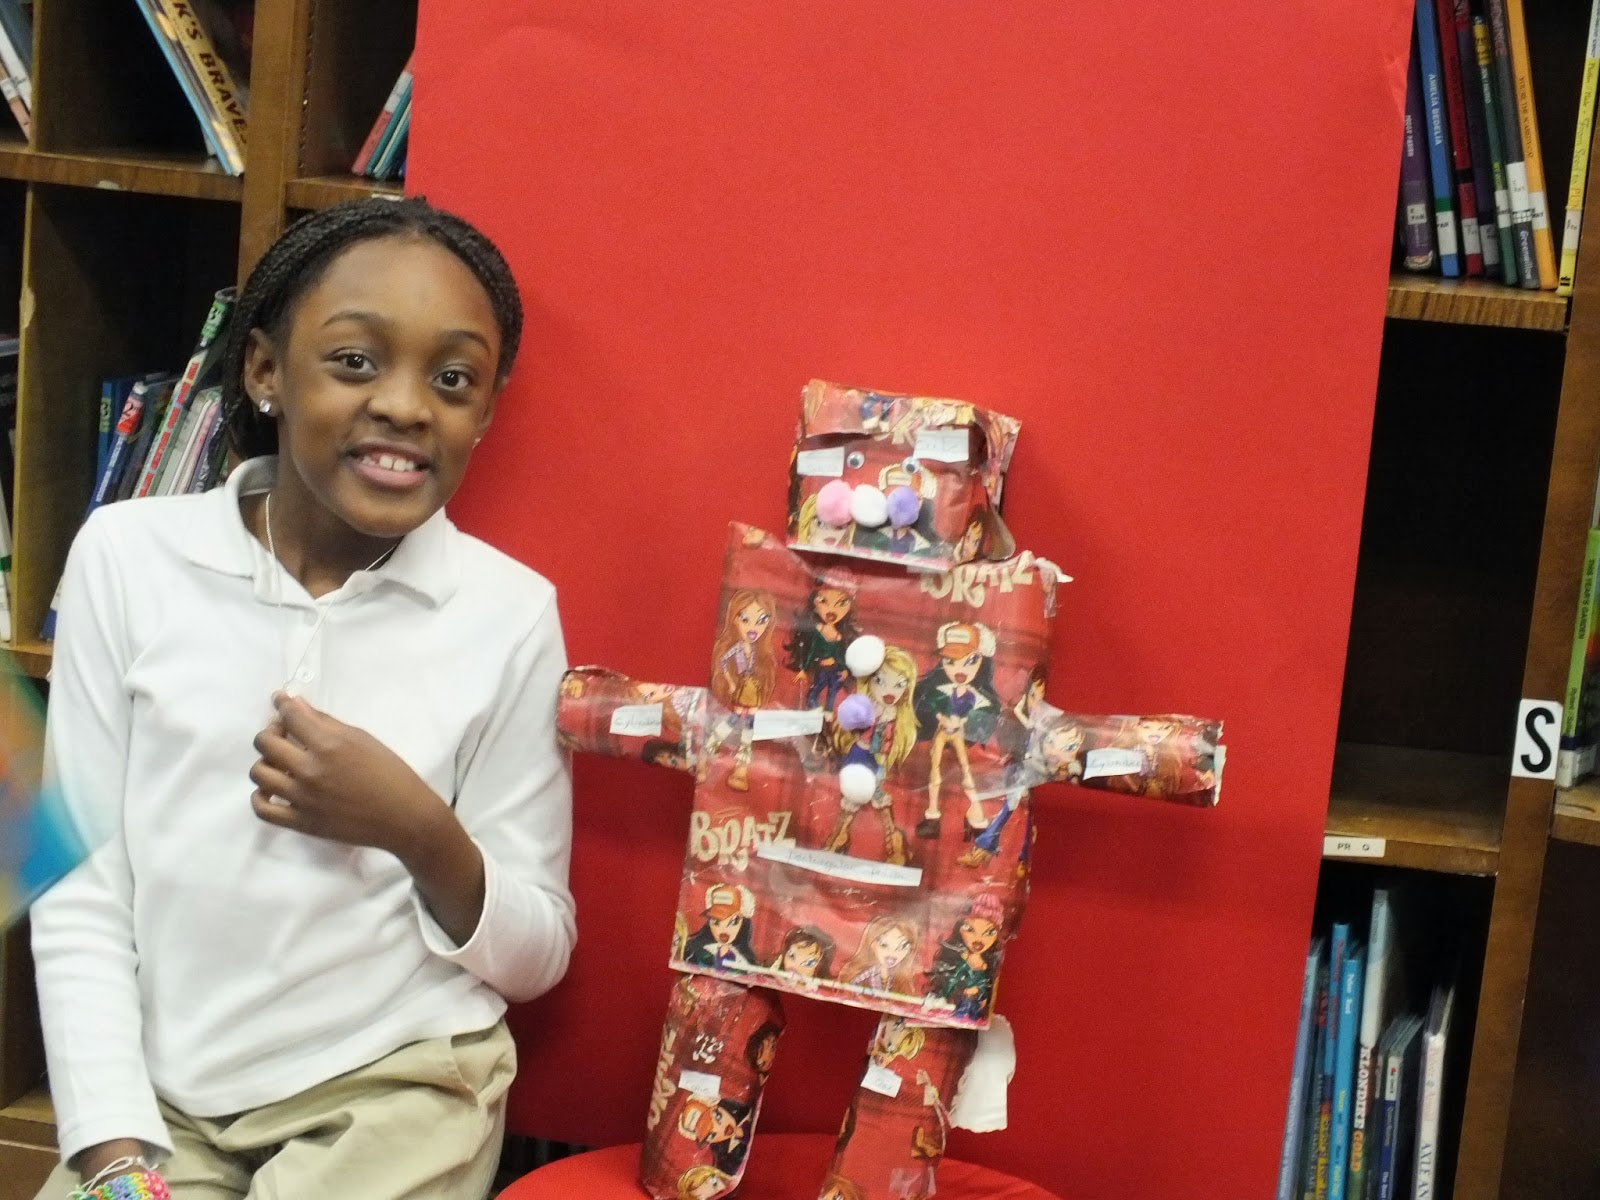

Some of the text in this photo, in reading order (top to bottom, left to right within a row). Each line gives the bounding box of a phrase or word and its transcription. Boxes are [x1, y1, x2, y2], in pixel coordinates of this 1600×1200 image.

[1428, 73, 1443, 146] AMELIA BEDELIA
[1520, 230, 1534, 280] Greenwillow
[1520, 706, 1556, 773] S
[690, 810, 796, 873] BRATZ
[1337, 842, 1351, 851] PR
[1353, 1046, 1371, 1129] KLONDIKE
[1350, 1130, 1364, 1173] GOLD
